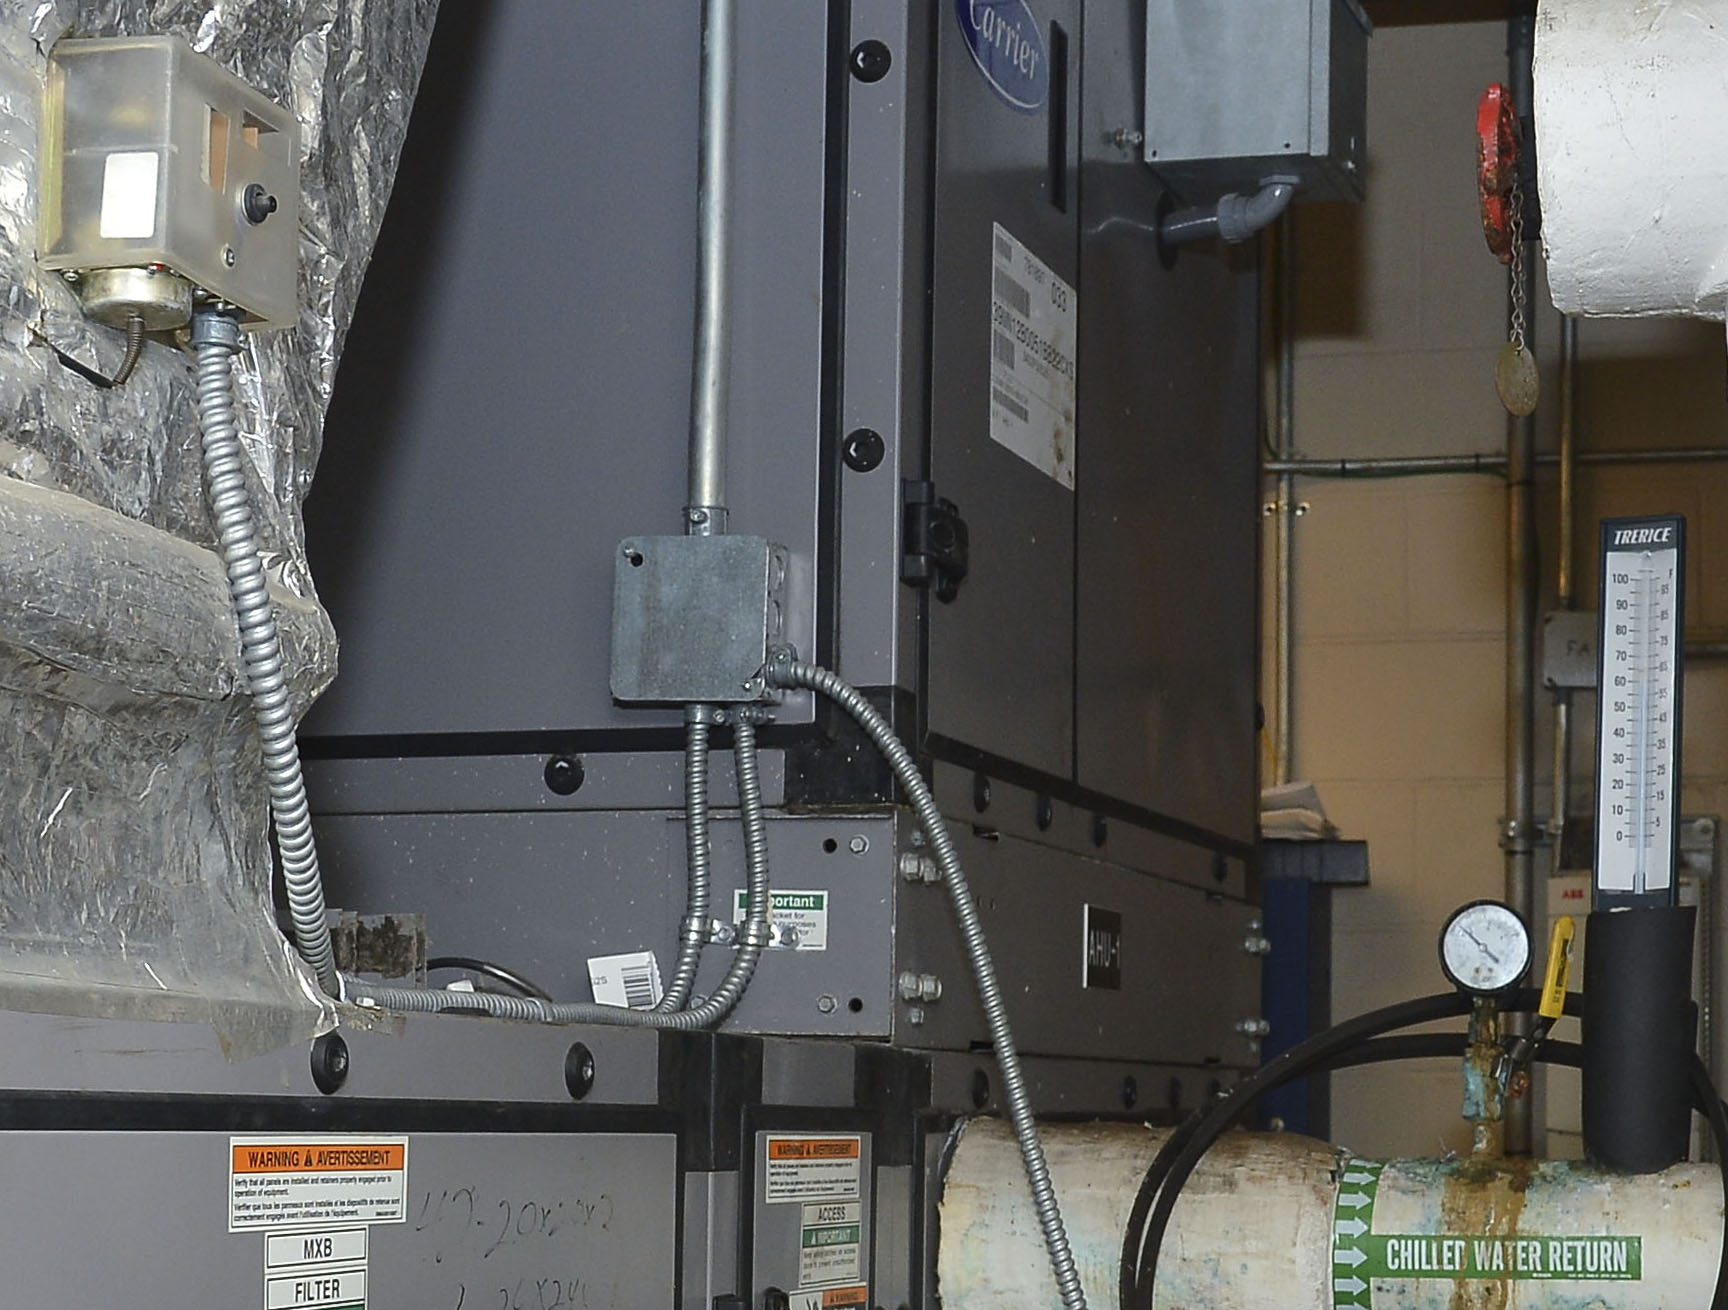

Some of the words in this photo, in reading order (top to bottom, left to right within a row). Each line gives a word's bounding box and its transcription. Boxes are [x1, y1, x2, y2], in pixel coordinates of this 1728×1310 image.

[970, 0, 1039, 79] Carrier
[1614, 527, 1672, 545] TRERICE
[1612, 574, 1629, 585] 100
[1661, 584, 1669, 595] 95
[1616, 600, 1628, 611] 90
[1660, 610, 1669, 621] 85
[1616, 625, 1627, 635] 80
[1616, 650, 1627, 661] 70
[1614, 676, 1626, 686] 60
[1614, 702, 1626, 713] 50
[1659, 713, 1667, 723] 45
[1613, 727, 1625, 738] 40
[1657, 739, 1666, 750] 35
[1612, 753, 1624, 764] 30
[1657, 764, 1666, 775] 25
[1612, 779, 1623, 790] 20
[1656, 790, 1664, 801] 15
[1611, 805, 1623, 815] 10
[1655, 817, 1661, 827] 5
[1616, 831, 1622, 841] 0
[1563, 890, 1584, 899] ABB
[248, 1151, 299, 1168] WARNING
[316, 1150, 390, 1166] AVERTISSEMENT
[818, 1206, 846, 1221] ACCESS
[817, 1229, 851, 1243] IMPORTANT
[304, 1238, 332, 1259] MXB
[1475, 1240, 1541, 1272] WATER
[1550, 1240, 1627, 1272] RETURN
[295, 1279, 340, 1303] FILTER
